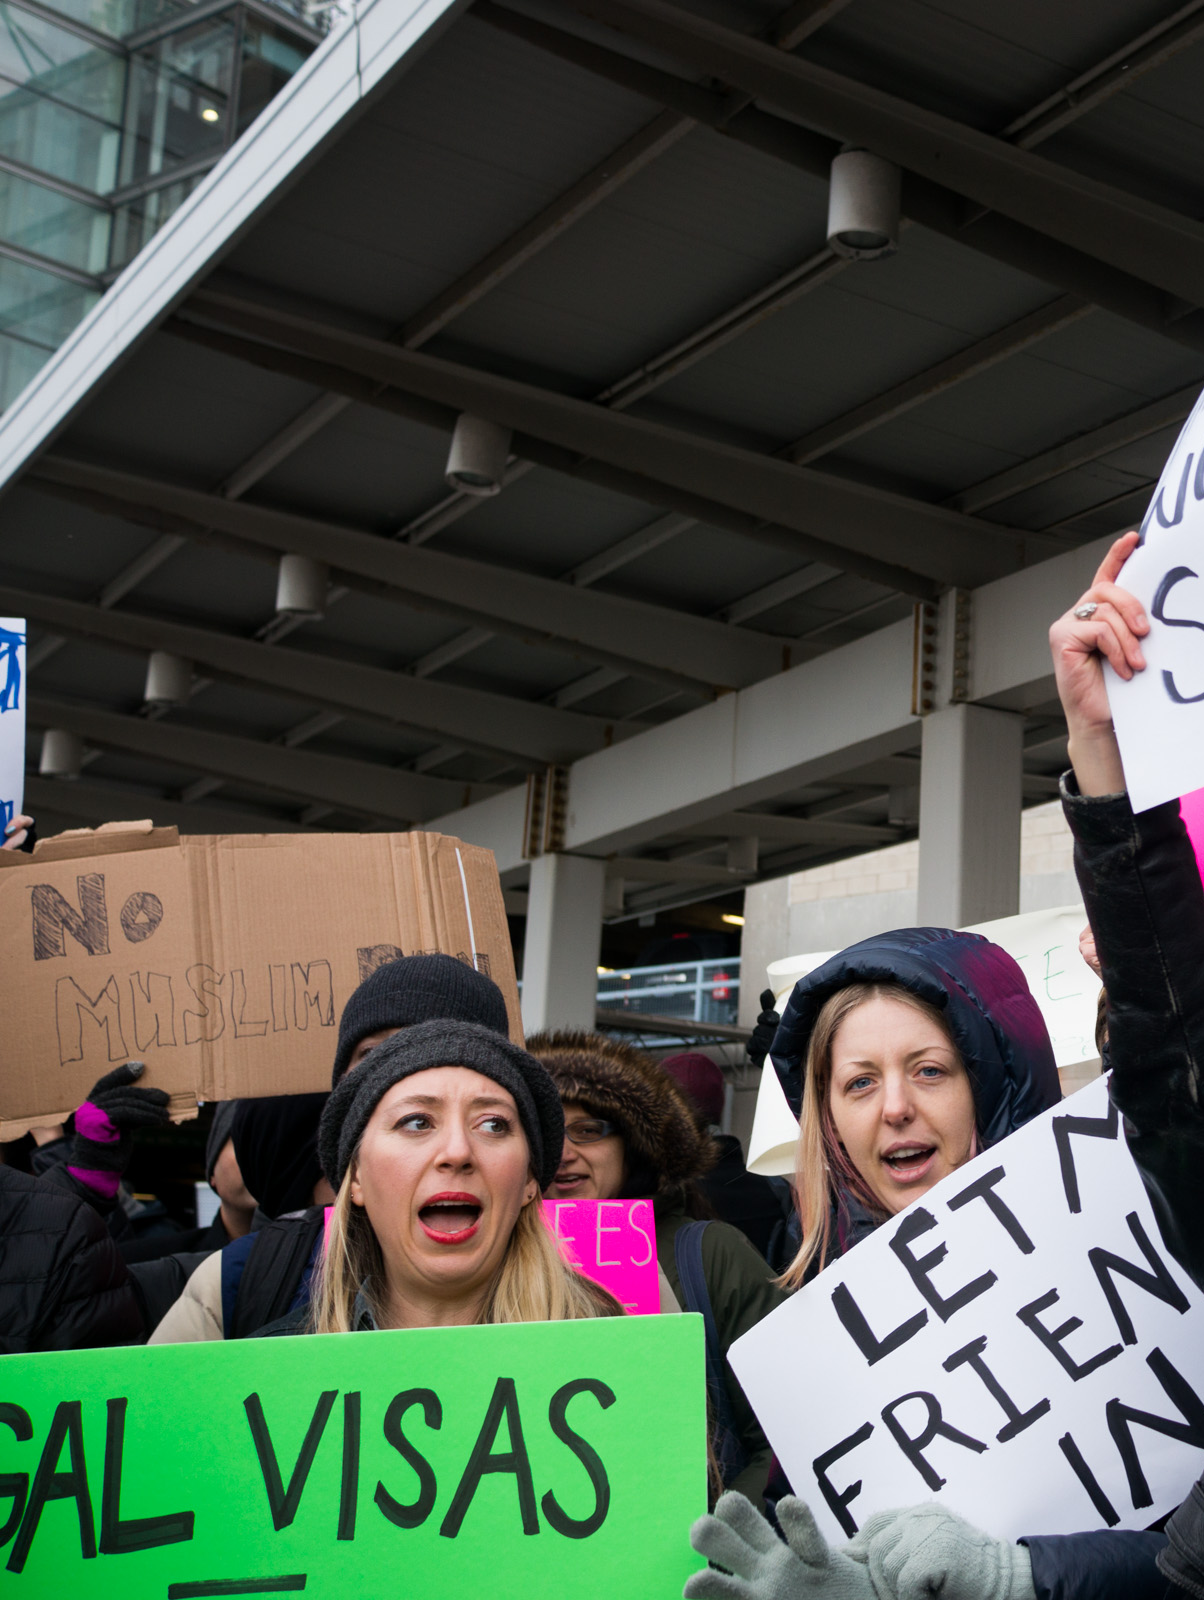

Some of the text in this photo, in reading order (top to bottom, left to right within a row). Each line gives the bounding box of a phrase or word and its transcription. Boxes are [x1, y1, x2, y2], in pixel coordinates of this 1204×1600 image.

[55, 958, 336, 1067] MUSLIM
[831, 1164, 1036, 1367] LET
[242, 1376, 617, 1541] VISAS
